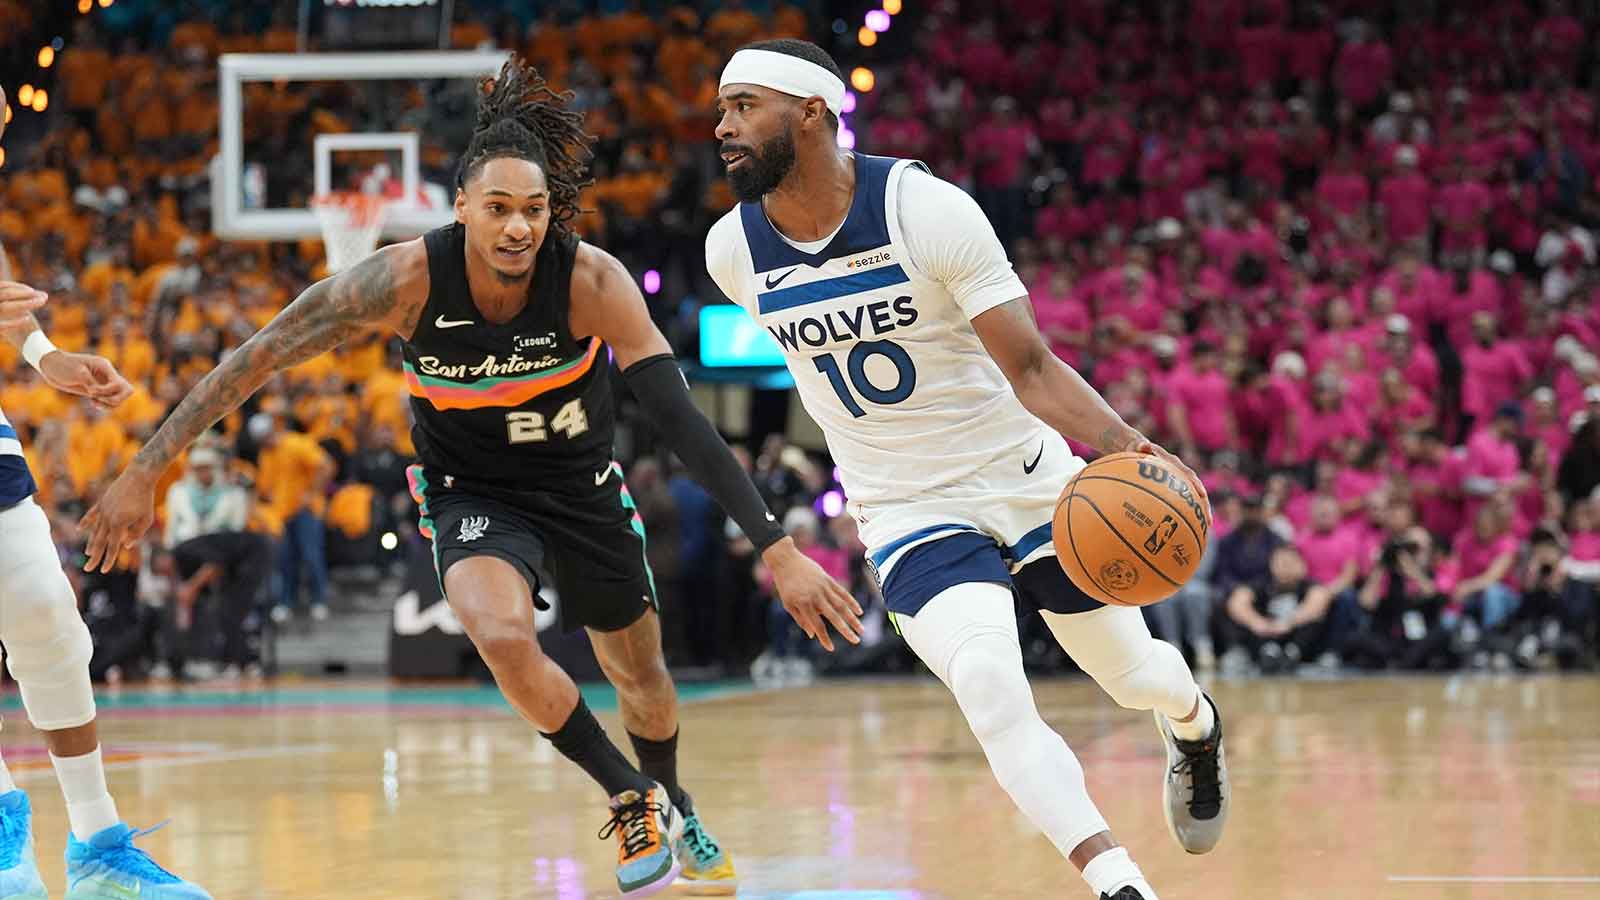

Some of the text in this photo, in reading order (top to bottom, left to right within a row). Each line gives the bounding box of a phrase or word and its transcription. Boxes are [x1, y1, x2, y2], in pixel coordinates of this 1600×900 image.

[854, 252, 891, 268] sezzle
[519, 336, 551, 348] LEDGER
[767, 296, 919, 352] WOLVES
[418, 353, 562, 379] San Antonio
[811, 338, 917, 419] 10
[505, 398, 589, 445] 24
